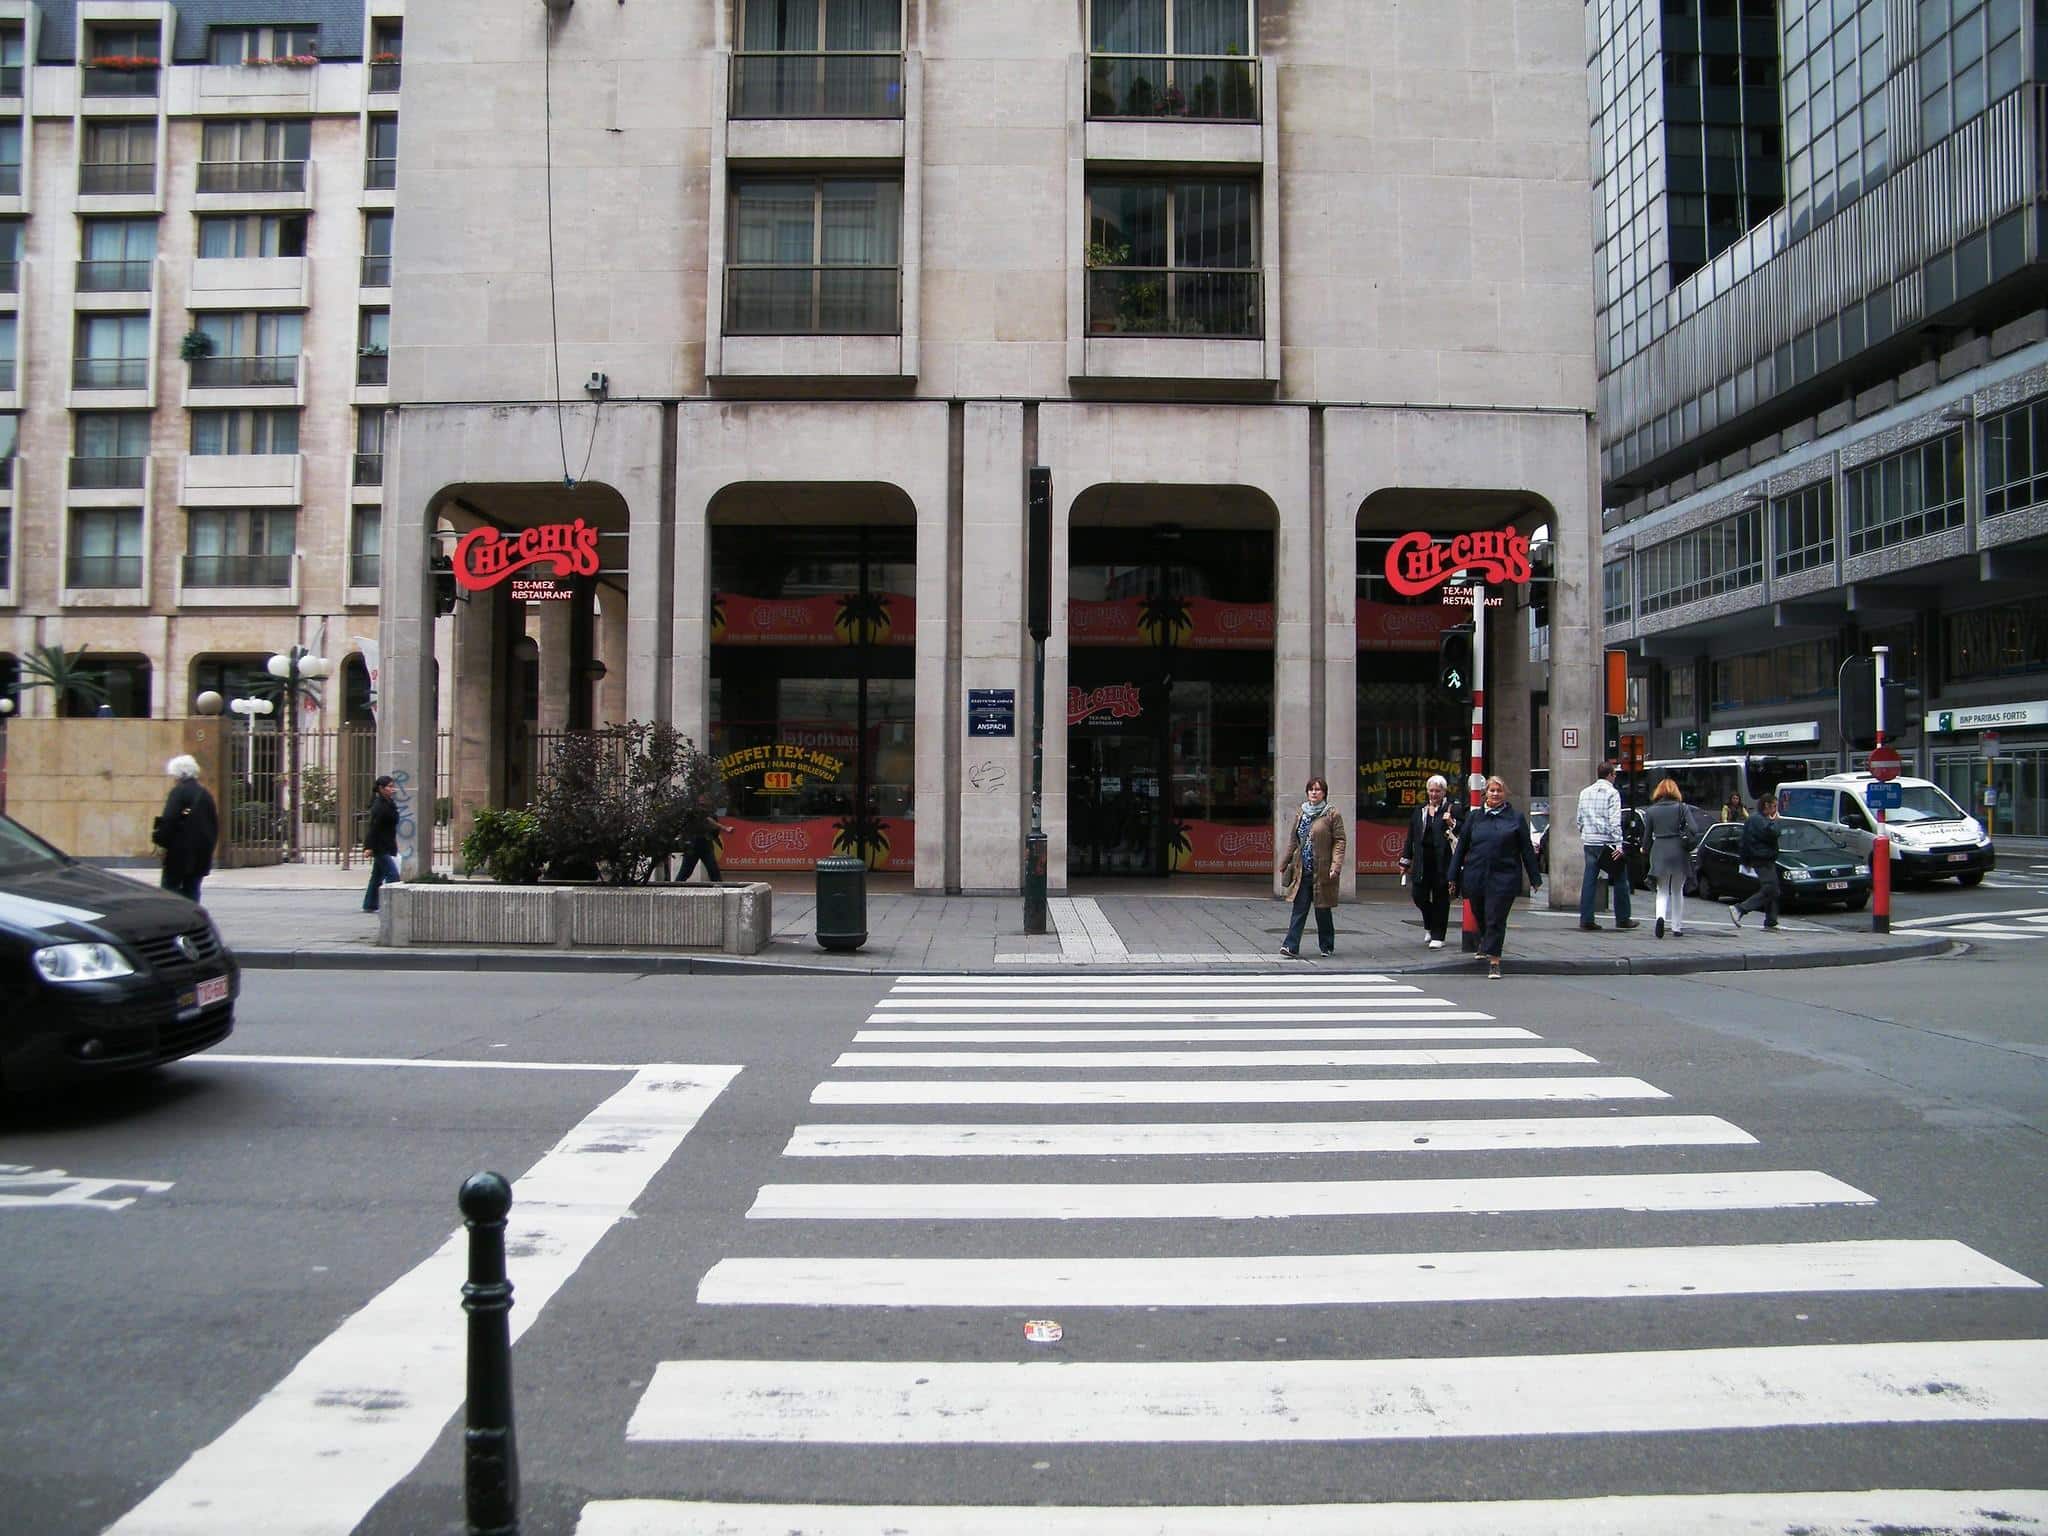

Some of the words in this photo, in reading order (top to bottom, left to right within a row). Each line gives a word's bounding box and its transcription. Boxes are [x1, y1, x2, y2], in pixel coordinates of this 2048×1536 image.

[511, 580, 555, 589] TEX-MEX
[511, 590, 573, 600] RESTAURANT
[1442, 586, 1474, 596] TEX-M
[1442, 597, 1504, 606] RESTAUANT
[1973, 713, 2001, 723] PARIBAS
[2002, 710, 2028, 721] FORTIS
[1566, 732, 1575, 744] H
[772, 760, 796, 769] NAAR
[775, 745, 845, 774] TEX-MEX
[1360, 757, 1413, 776] HAPPY
[1416, 757, 1462, 775] HOUR
[1367, 782, 1385, 794] ALL
[1387, 779, 1427, 790] COCKT
